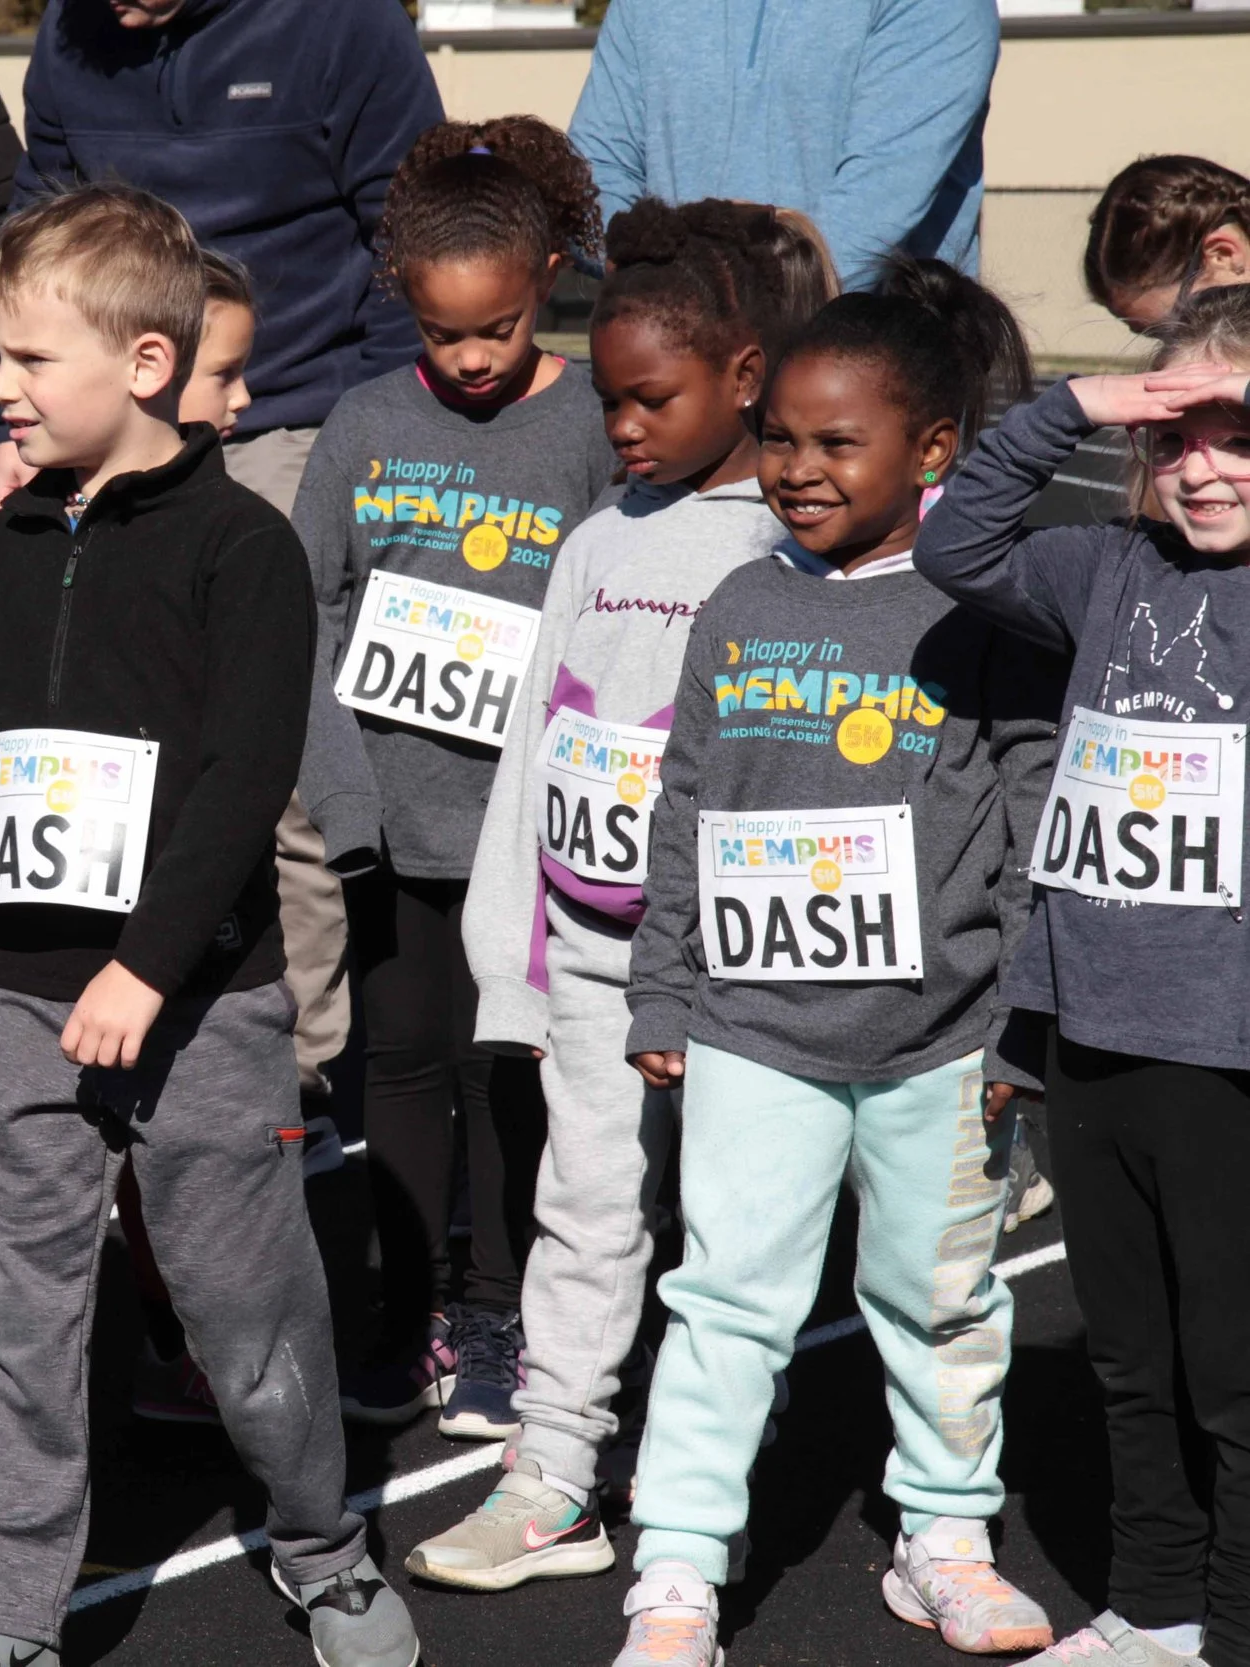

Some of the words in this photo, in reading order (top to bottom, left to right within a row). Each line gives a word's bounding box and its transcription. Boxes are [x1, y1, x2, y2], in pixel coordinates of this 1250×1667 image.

[385, 458, 452, 486] Happy
[455, 461, 476, 485] in
[354, 484, 563, 546] MEMPHIS
[408, 536, 459, 553] ACADEMY
[469, 535, 503, 559] 5K
[510, 546, 550, 570] 2021
[409, 582, 451, 604] Happy
[454, 591, 466, 606] in
[384, 595, 522, 649] MEMPHIS
[743, 638, 816, 666] Happy
[819, 637, 844, 662] in
[350, 640, 519, 735] DASH
[714, 667, 947, 727] MEMPHIS
[1114, 690, 1197, 723] MEMPHIS
[573, 718, 603, 743] Happy
[605, 727, 618, 743] in
[719, 726, 771, 740] HARDING
[770, 715, 818, 730] presented
[820, 719, 834, 733] by
[844, 722, 885, 750] 5K
[1085, 716, 1113, 742] Happy
[1115, 723, 1128, 742] in
[35, 734, 49, 748] in
[554, 732, 664, 783] MEMPHI
[1070, 737, 1209, 784] MEMPHIS
[1133, 783, 1161, 802] 5K
[546, 782, 656, 875] DAS
[735, 818, 785, 837] Happy
[787, 816, 802, 832] in
[720, 834, 876, 867] MEMPHIS
[1042, 795, 1221, 894] DASH
[814, 868, 838, 885] 5K
[714, 893, 898, 969] DASH
